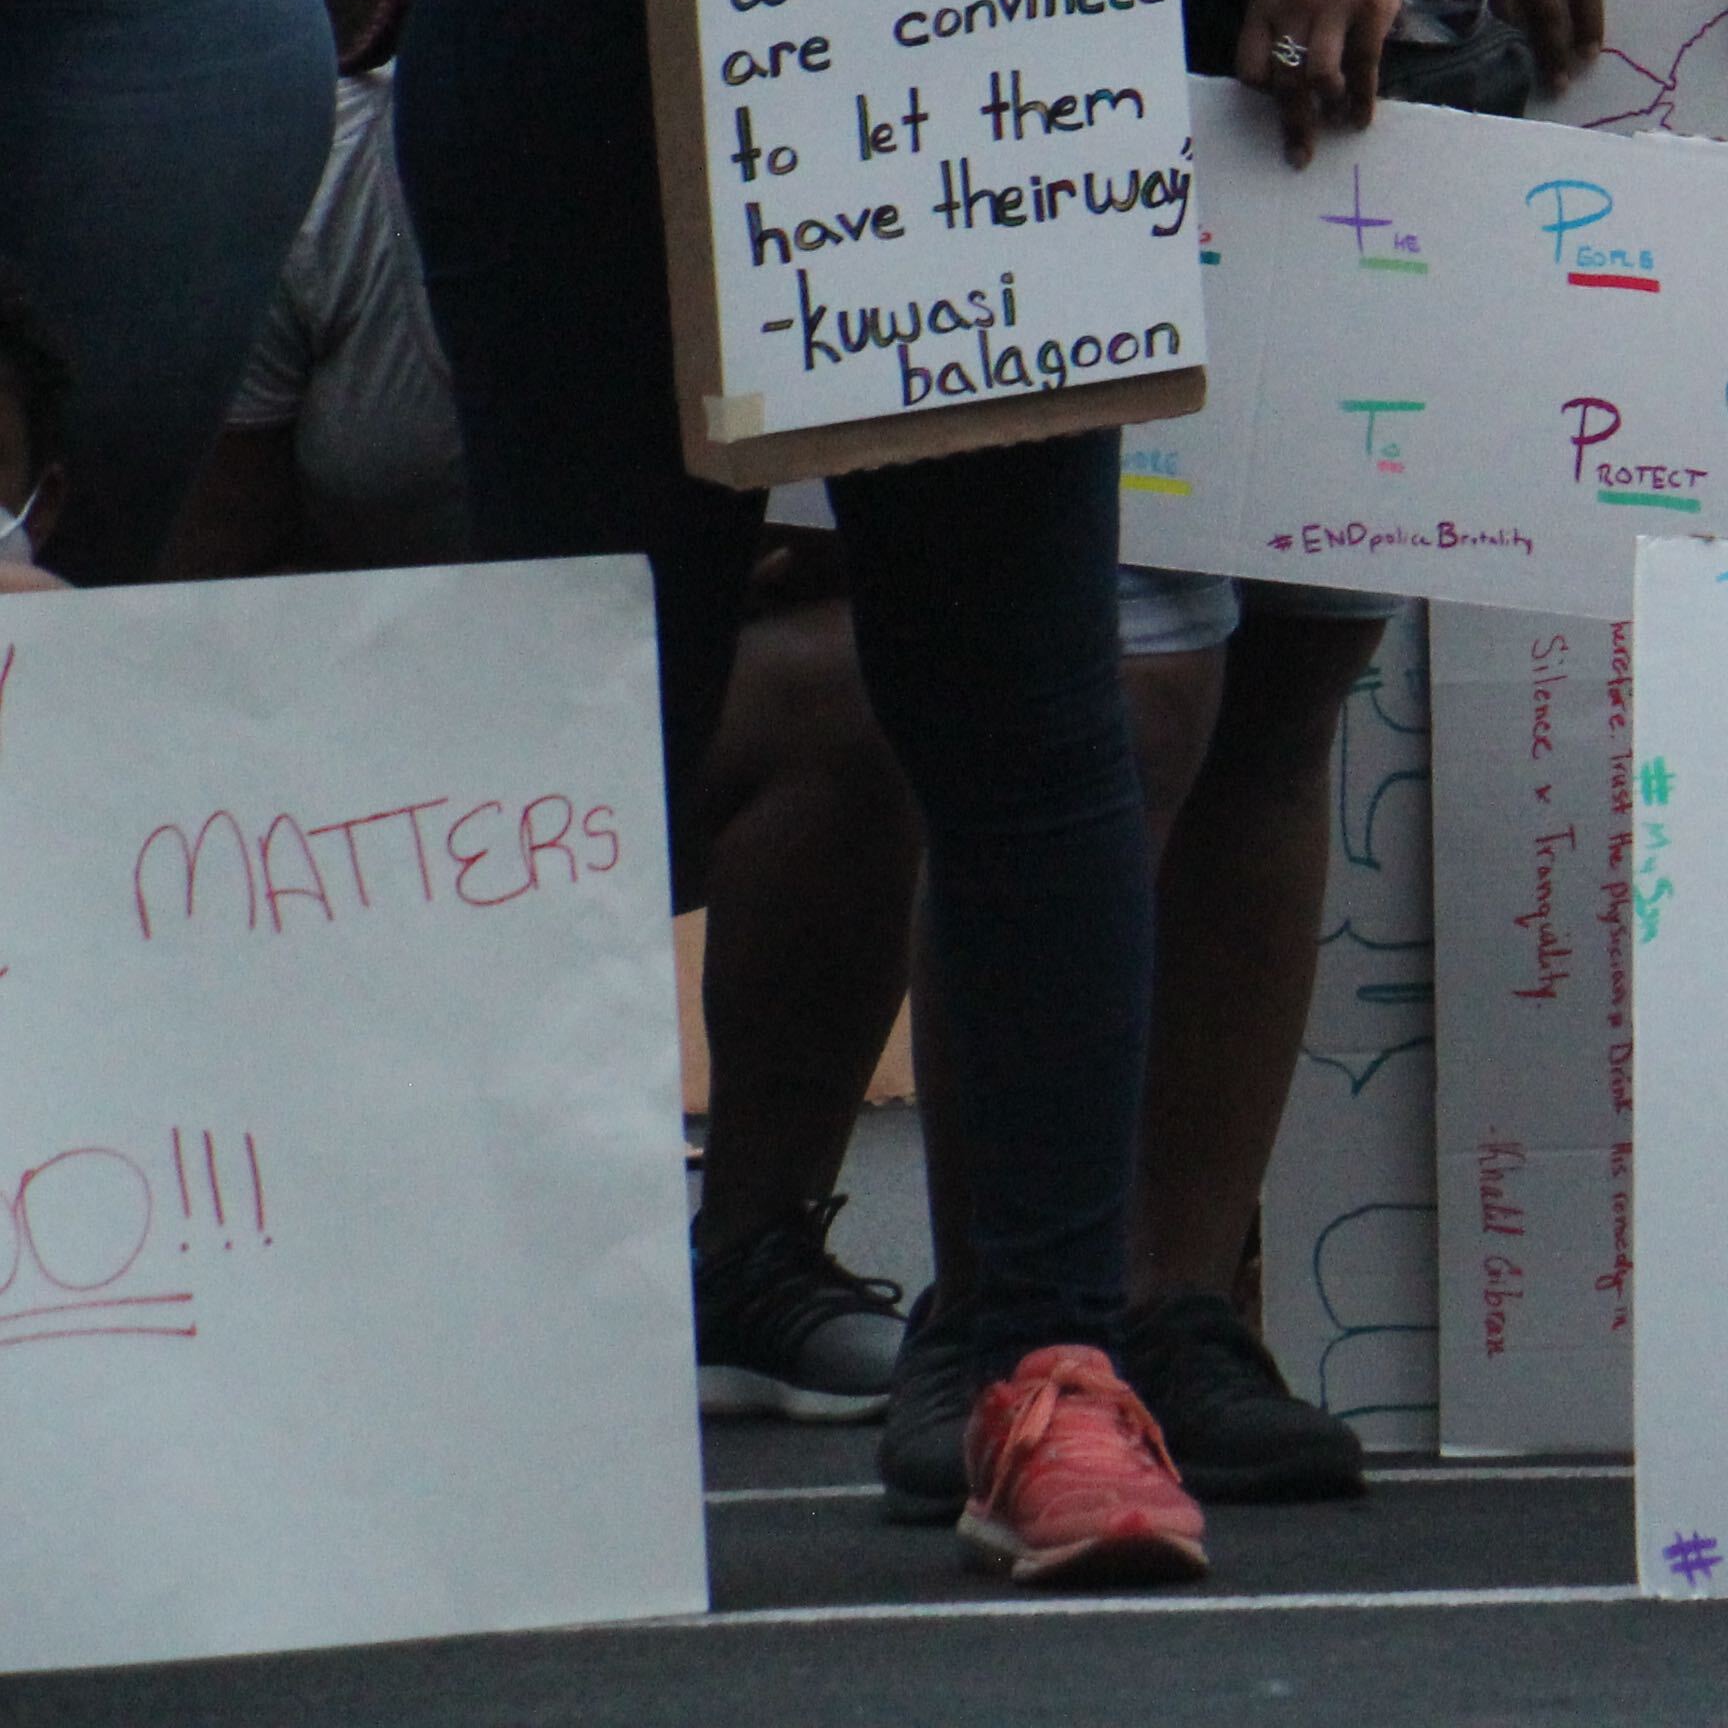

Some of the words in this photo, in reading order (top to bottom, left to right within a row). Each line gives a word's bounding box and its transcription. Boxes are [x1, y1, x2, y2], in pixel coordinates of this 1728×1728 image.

[721, 31, 831, 85] are
[733, 107, 798, 182] to
[857, 87, 930, 163] let
[981, 70, 1146, 144] them
[746, 202, 906, 267] have
[934, 158, 1075, 229] their
[900, 320, 1182, 406] balagoon
[1531, 634, 1569, 759] Silence
[132, 795, 620, 941] MATTERS
